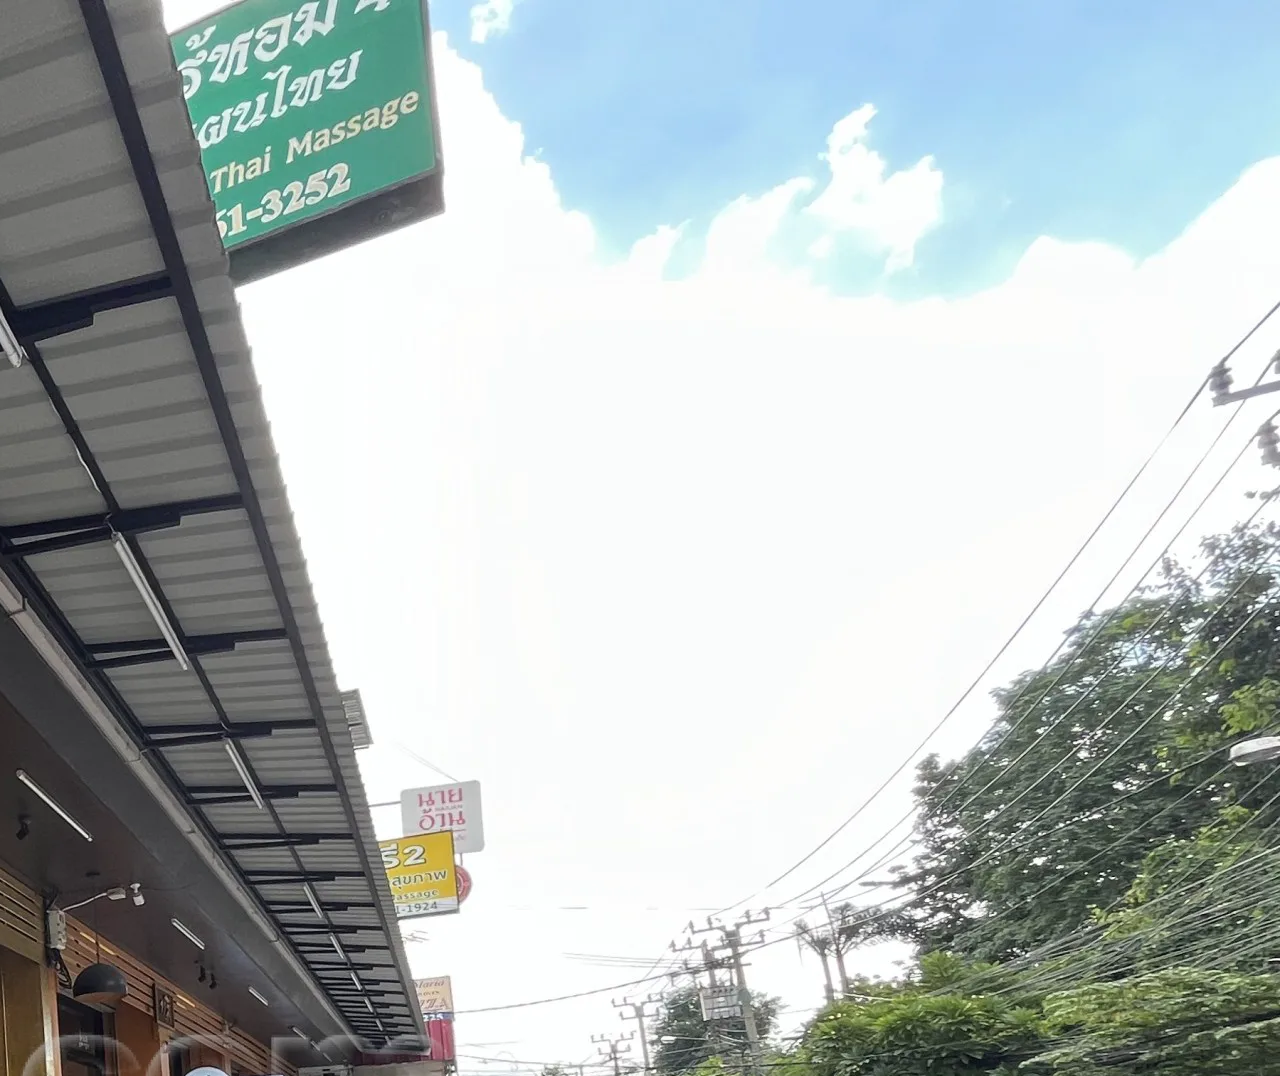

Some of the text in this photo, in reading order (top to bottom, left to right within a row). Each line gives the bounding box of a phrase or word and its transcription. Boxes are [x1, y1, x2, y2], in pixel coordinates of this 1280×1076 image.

[192, 49, 363, 149] ผนไทย
[209, 90, 419, 194] Thai Massage
[417, 787, 463, 807] นาย
[402, 844, 427, 867] 2
[392, 889, 439, 901] assage
